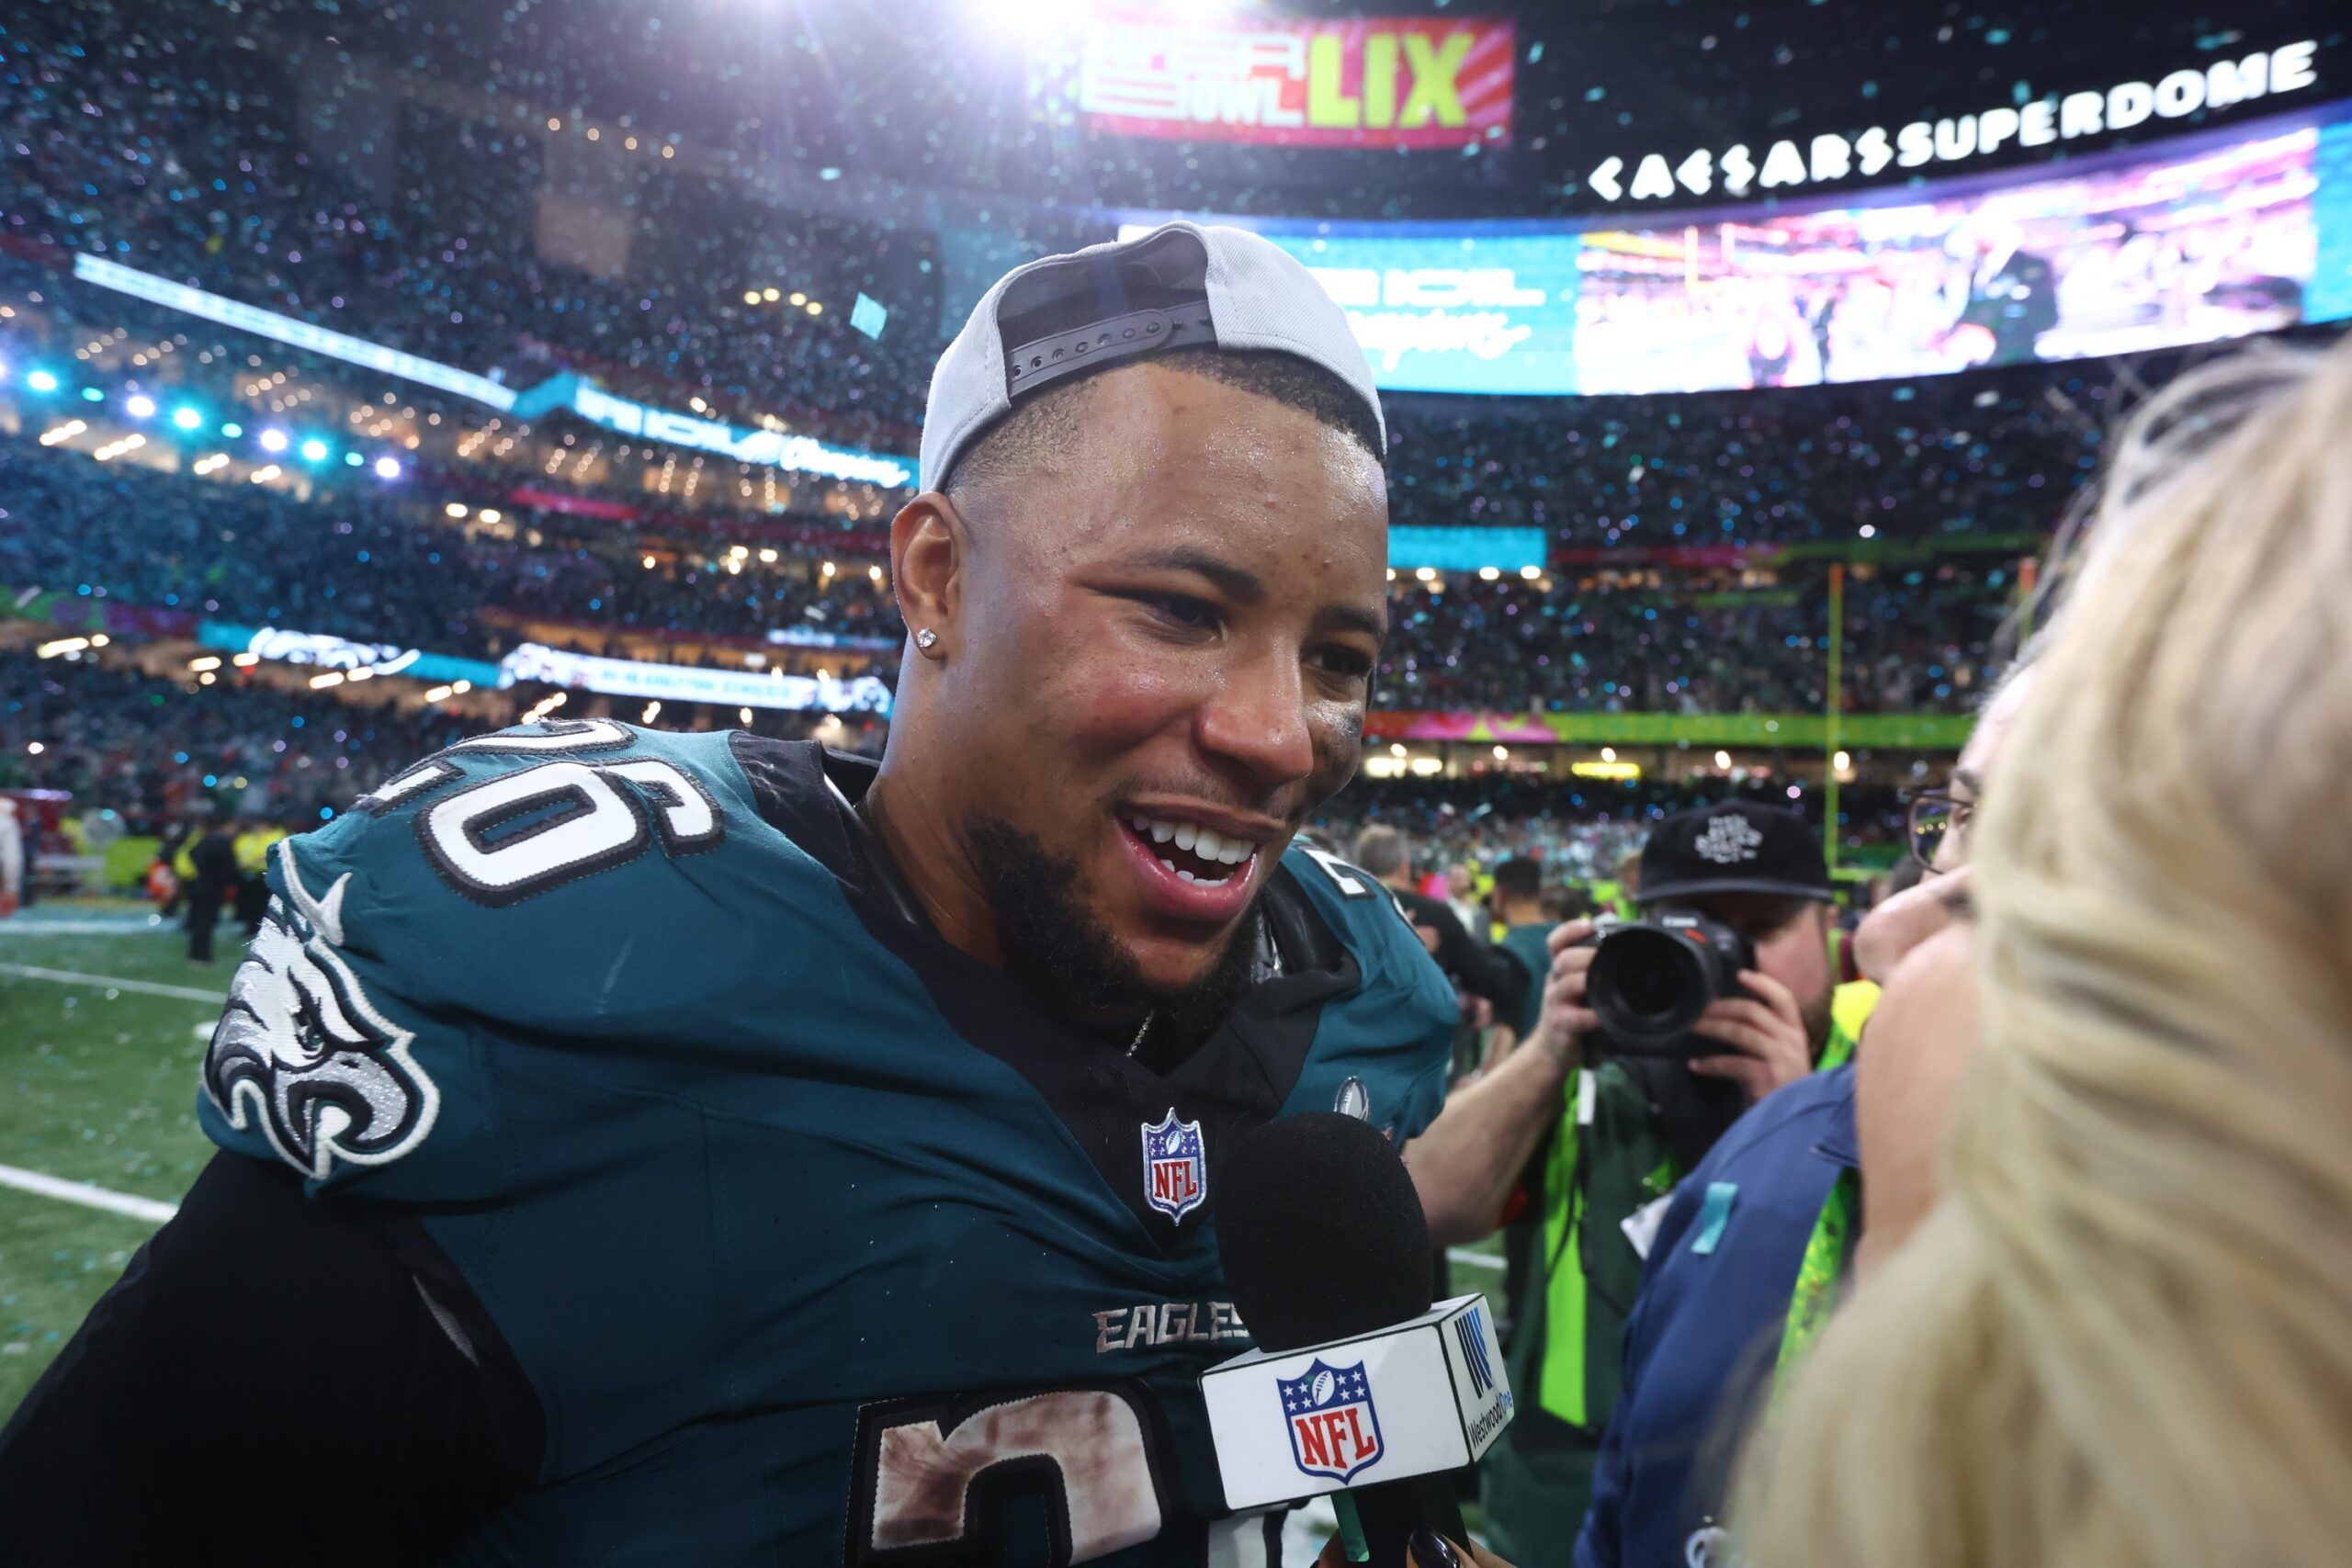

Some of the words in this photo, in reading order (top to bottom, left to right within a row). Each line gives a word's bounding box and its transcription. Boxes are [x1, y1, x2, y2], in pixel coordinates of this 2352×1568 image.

[1307, 33, 1472, 128] LIX
[1588, 127, 1894, 201] CAESARS
[1896, 40, 2317, 167] SUPERDOME
[1154, 1160, 1197, 1203] NFL
[1295, 1407, 1376, 1470] NFL
